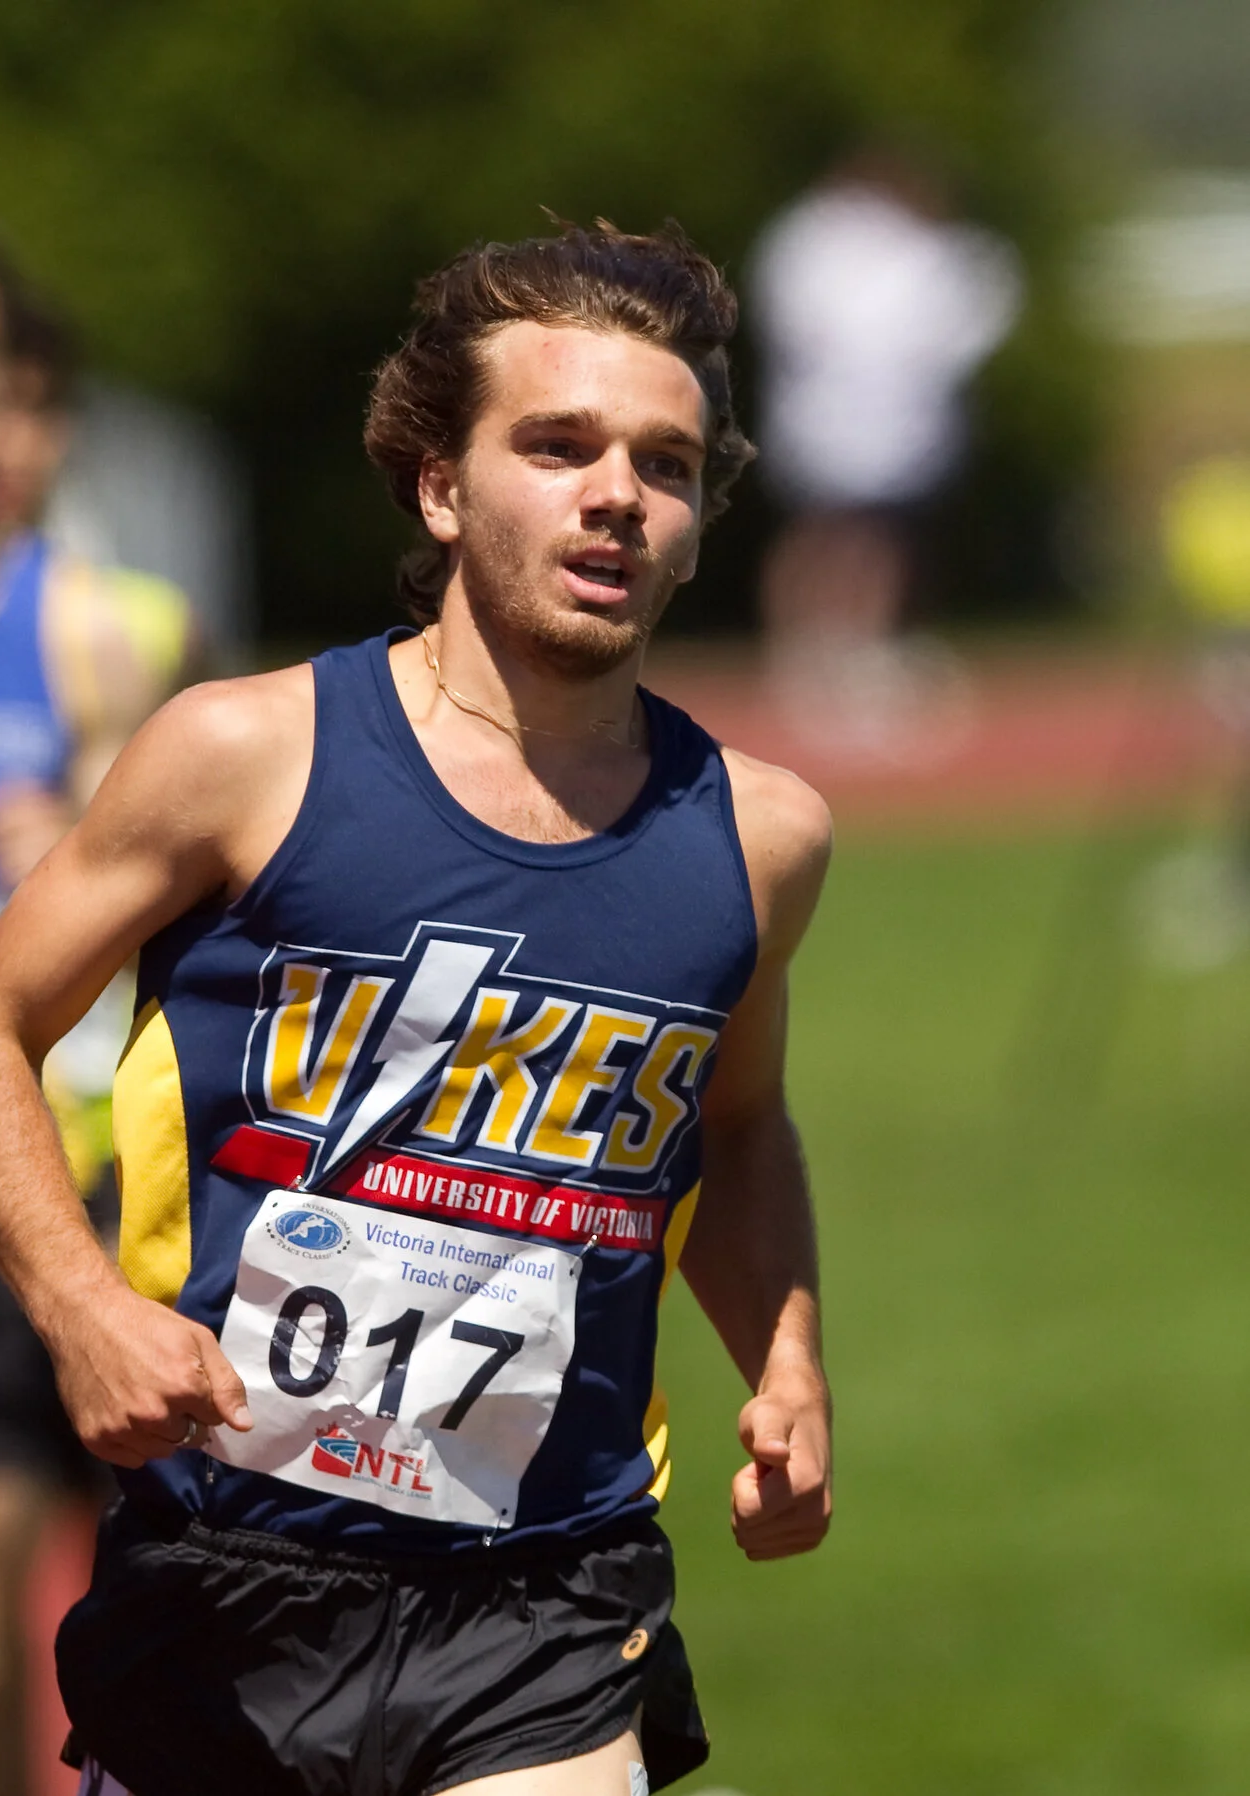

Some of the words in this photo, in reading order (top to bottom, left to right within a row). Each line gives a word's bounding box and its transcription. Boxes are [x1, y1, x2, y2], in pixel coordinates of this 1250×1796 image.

[262, 939, 721, 1172] VIKES
[362, 1161, 529, 1220] UNIVERSITY
[530, 1196, 565, 1227] OF
[570, 1202, 653, 1240] VICTORIA
[366, 1222, 434, 1255] Victoria
[439, 1239, 555, 1281] International
[401, 1261, 449, 1289] Track
[453, 1273, 518, 1304] Classic
[268, 1285, 525, 1431] 017
[354, 1442, 433, 1492] NTL
